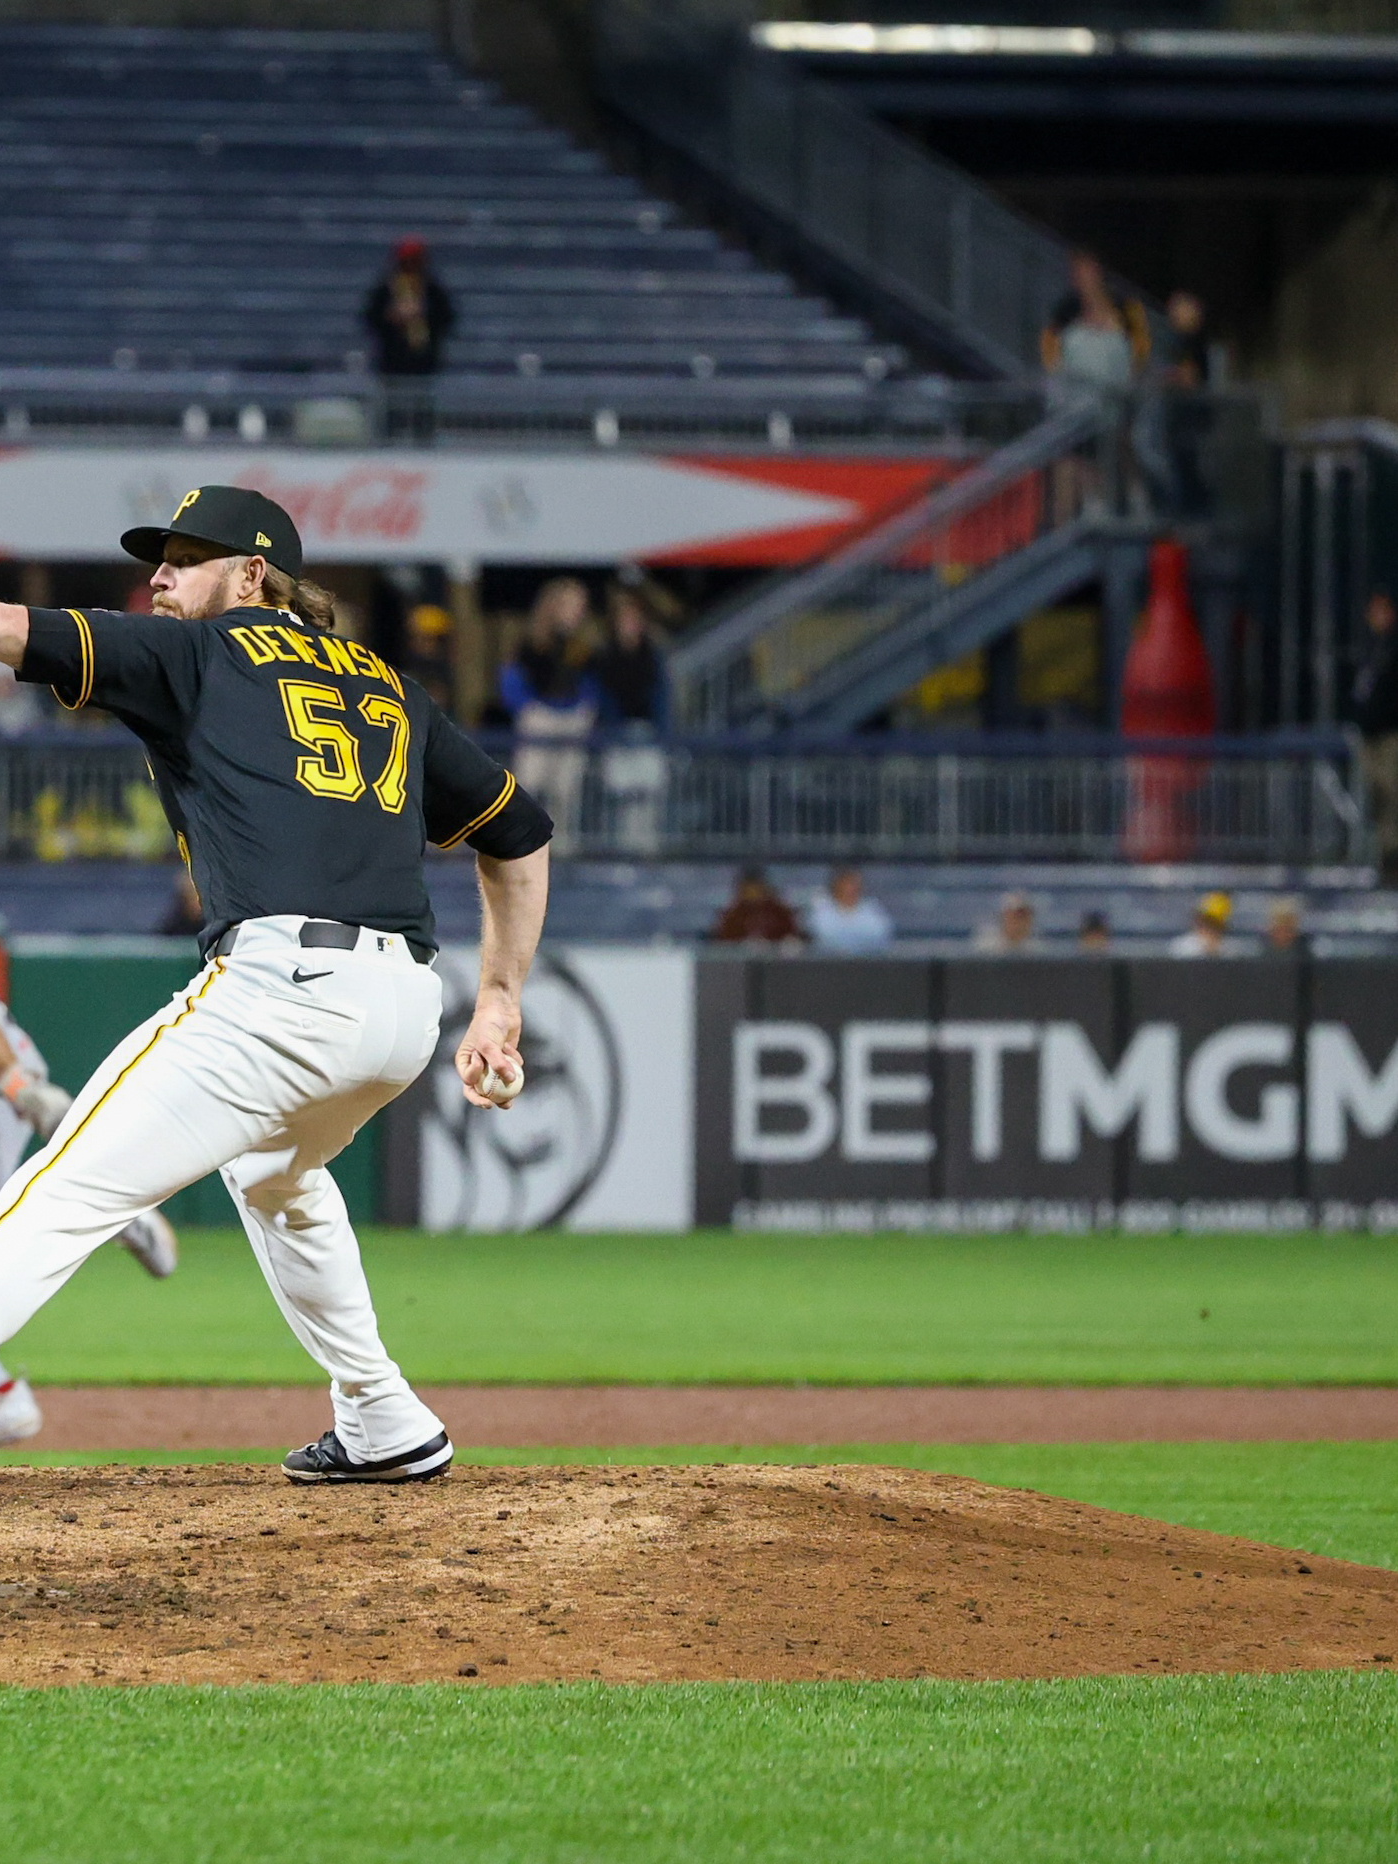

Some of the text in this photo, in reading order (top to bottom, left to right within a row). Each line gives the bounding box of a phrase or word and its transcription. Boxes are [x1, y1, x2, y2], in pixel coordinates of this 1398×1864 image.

[172, 489, 202, 521] P
[278, 678, 411, 815] 57
[732, 1020, 1398, 1162] BETMGM
